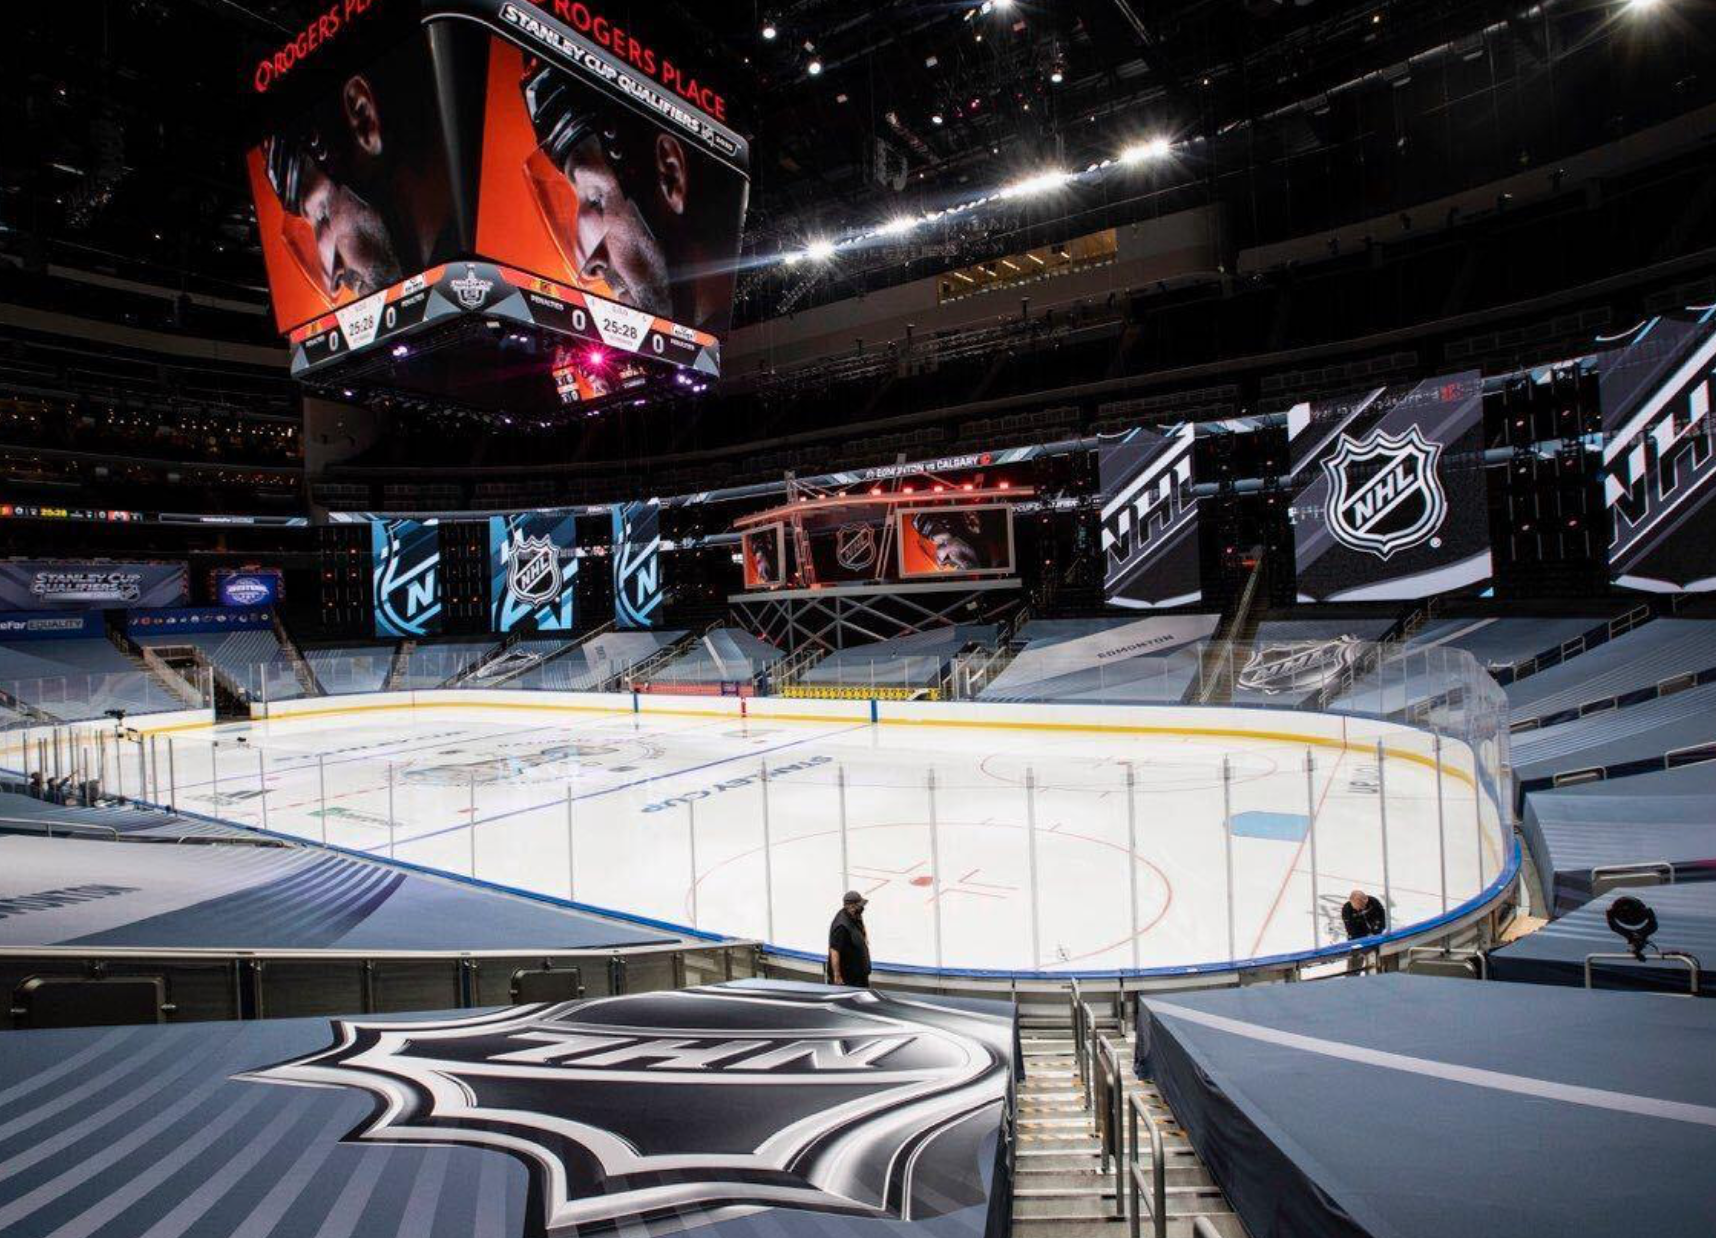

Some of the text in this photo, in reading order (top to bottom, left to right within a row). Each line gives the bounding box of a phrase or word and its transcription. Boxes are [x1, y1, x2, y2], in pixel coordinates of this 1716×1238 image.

[274, 4, 340, 78] ROGERS
[504, 4, 700, 132] STANLEY CUP QUALIFIERS
[554, 0, 727, 121] ROGERS PLACE
[386, 306, 396, 328] 0
[572, 309, 586, 331] 0
[603, 318, 638, 339] 25:28
[329, 330, 339, 351] 0
[652, 333, 664, 353] 0
[937, 455, 978, 470] CALGARY
[1350, 460, 1421, 528] NHL
[35, 572, 140, 583] STANLEY CUP
[519, 549, 551, 589] NHL
[31, 583, 121, 594] QUALIFIERS
[1097, 634, 1175, 660] EDMONTON
[486, 1030, 917, 1070] NHL
